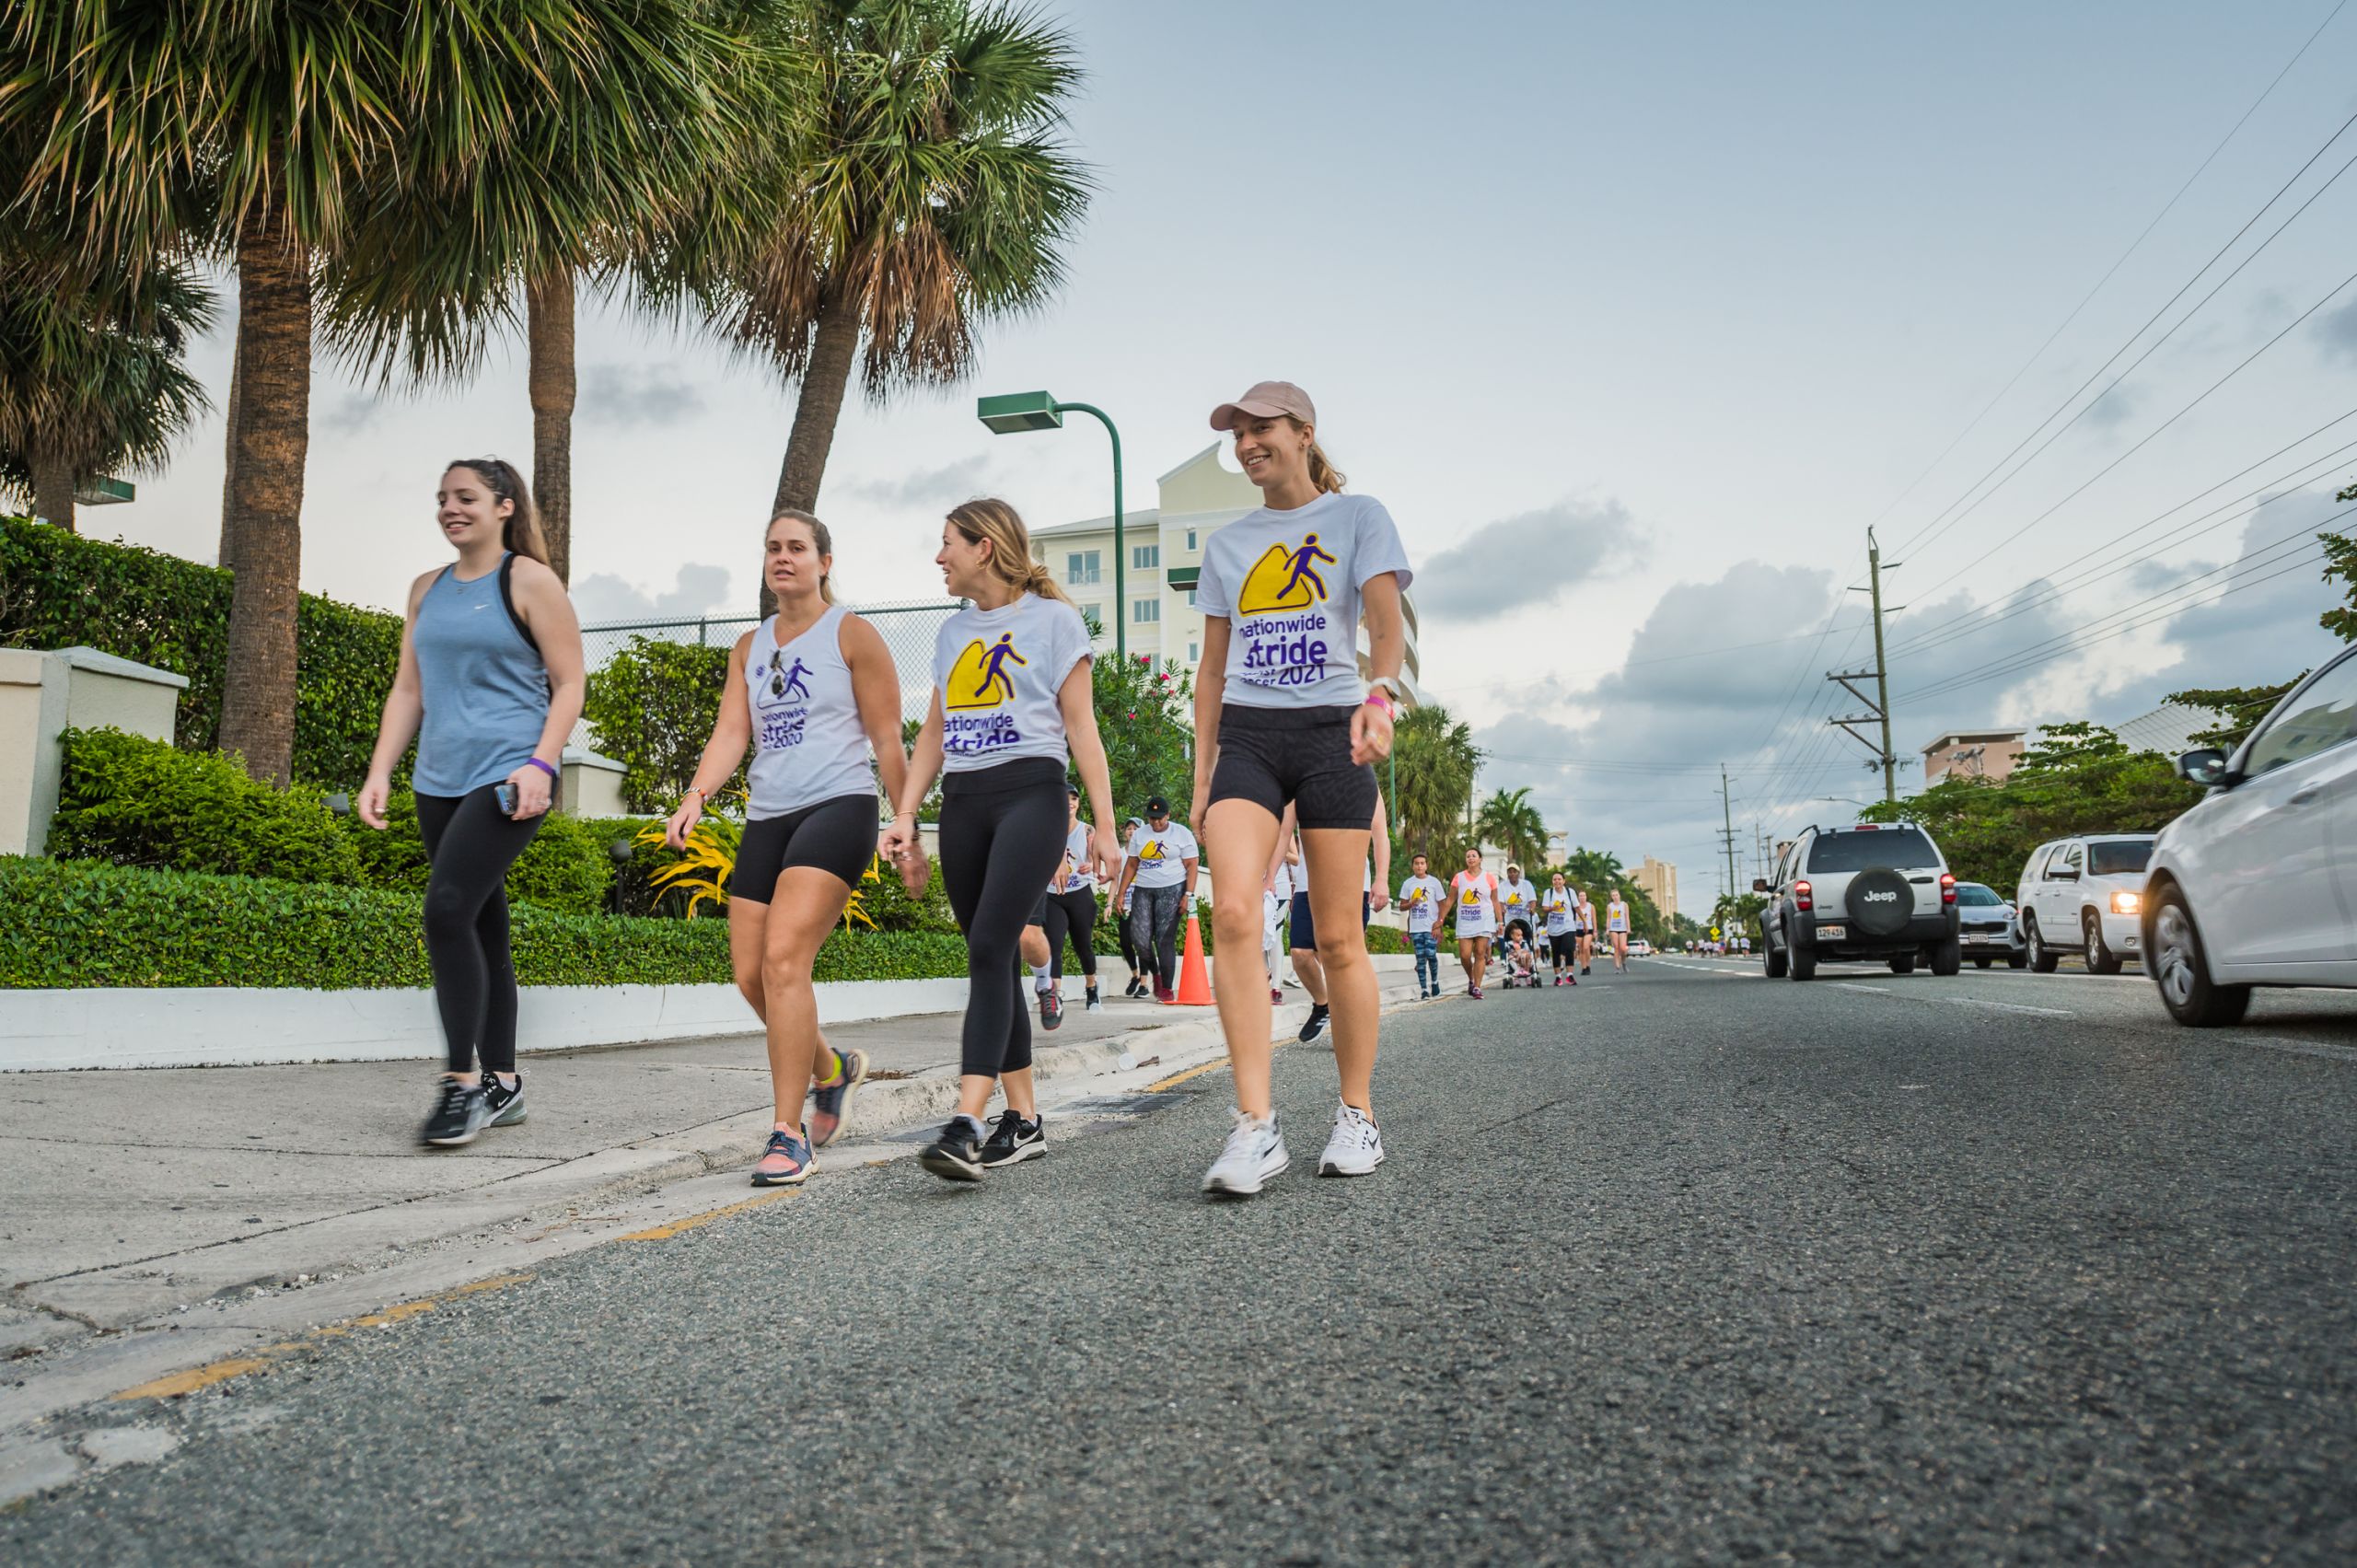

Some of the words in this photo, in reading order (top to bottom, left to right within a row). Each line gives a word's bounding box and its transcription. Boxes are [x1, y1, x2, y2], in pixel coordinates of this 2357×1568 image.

[1238, 613, 1326, 639] nationwide
[1243, 633, 1328, 668] stride
[1278, 664, 1324, 685] 2021
[944, 713, 1014, 732] ationwide
[1864, 890, 1897, 902] Jeep
